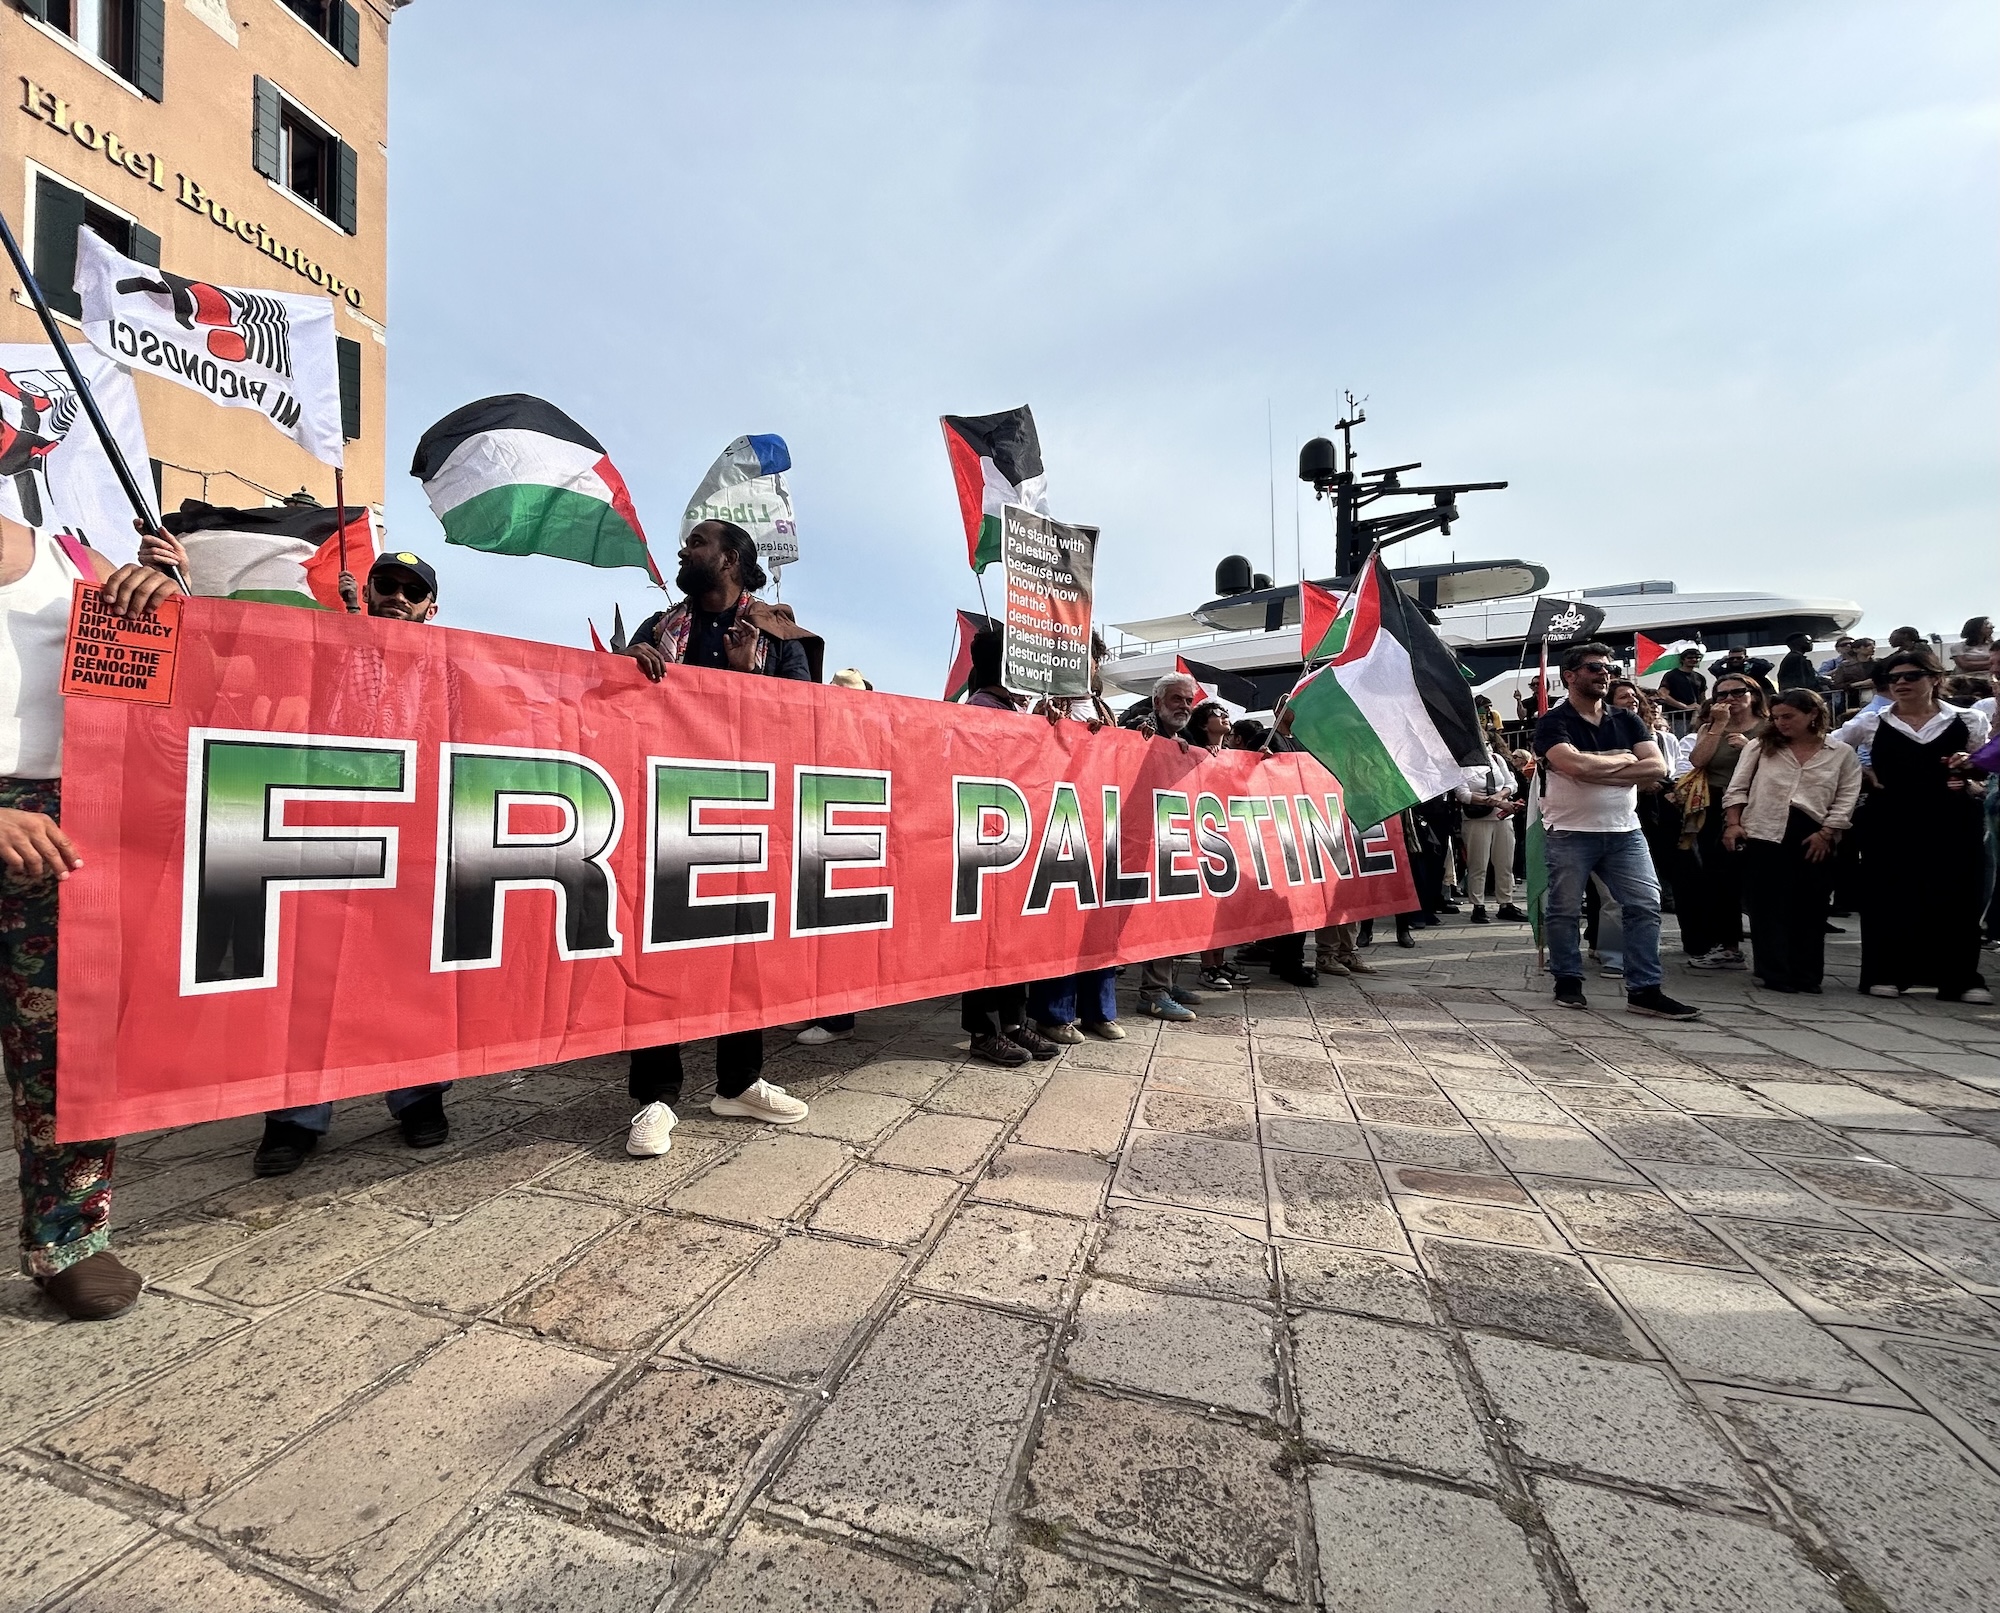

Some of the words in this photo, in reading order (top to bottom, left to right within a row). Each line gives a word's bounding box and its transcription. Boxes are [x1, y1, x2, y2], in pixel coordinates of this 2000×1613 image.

[19, 76, 165, 192] Hotel
[176, 173, 365, 308] Bucintoro
[1008, 519, 1026, 537] We
[1027, 529, 1057, 548] stand
[1059, 538, 1085, 554] with
[1008, 537, 1059, 564] Palestine
[1007, 554, 1053, 580] because
[1054, 572, 1073, 584] we
[1009, 572, 1036, 592] know
[1036, 581, 1051, 599] by
[1052, 588, 1078, 602] now
[1009, 590, 1029, 608] that
[1029, 597, 1046, 612] the
[78, 625, 120, 643] NOW.
[80, 612, 173, 638] DIPLOMACY
[1008, 608, 1070, 634] destruction
[1071, 624, 1083, 637] of
[75, 642, 99, 657] NO
[104, 646, 125, 660] TO
[130, 650, 160, 665] THE
[1008, 625, 1055, 649] Palestine
[1057, 637, 1068, 651] is
[1069, 640, 1087, 655] the
[73, 655, 158, 678] GENOCIDE
[1008, 643, 1068, 668] destruction
[1069, 657, 1081, 670] of
[71, 669, 147, 690] PAVILION
[1008, 661, 1025, 677] the
[1026, 667, 1053, 683] world
[180, 726, 894, 997] FREE
[950, 775, 1397, 922] PALESTINE
